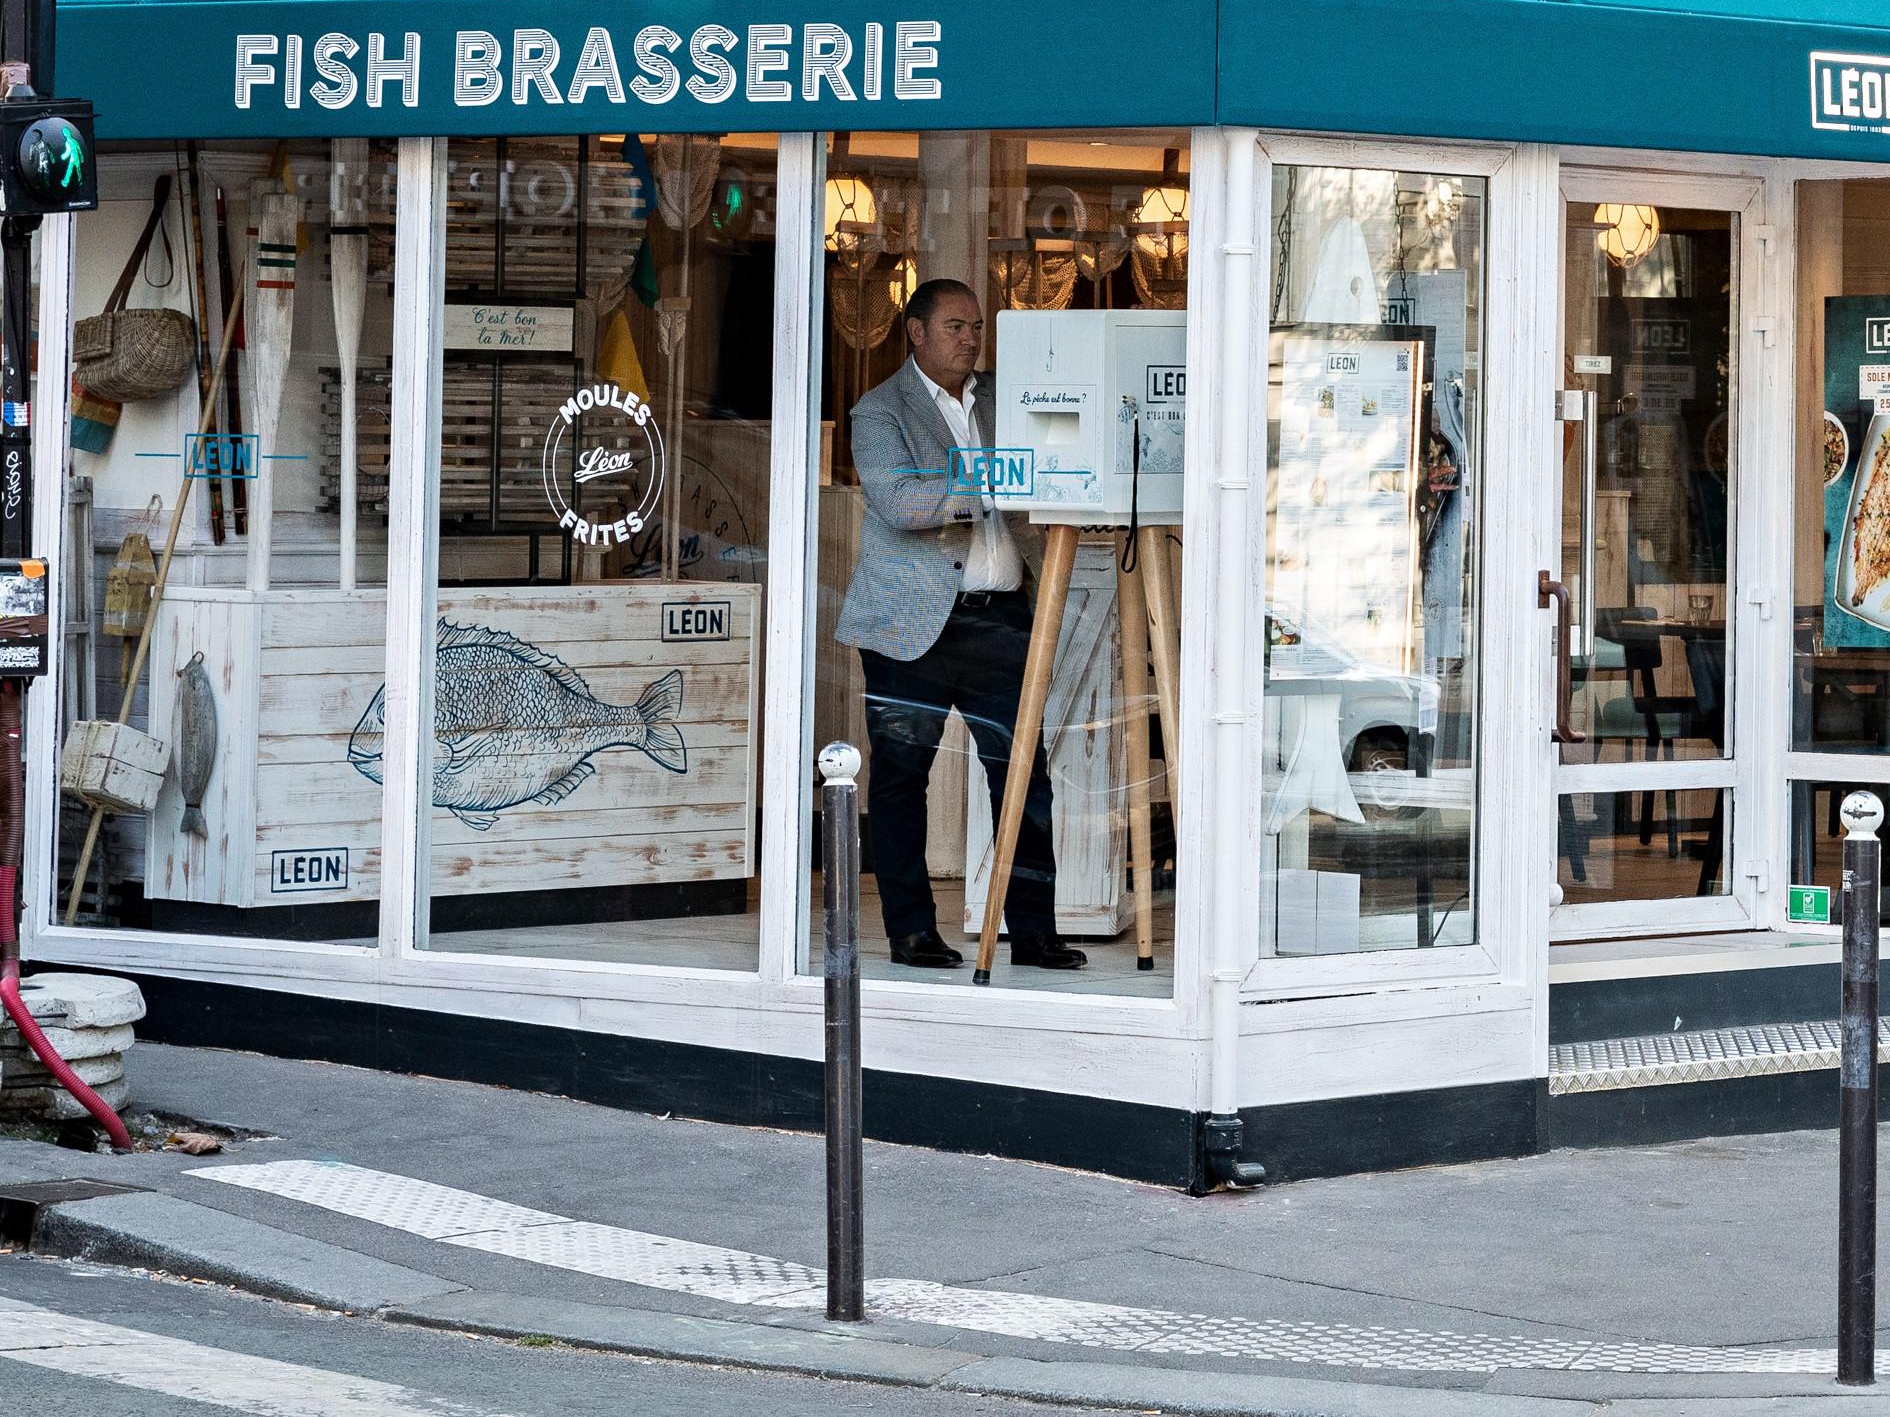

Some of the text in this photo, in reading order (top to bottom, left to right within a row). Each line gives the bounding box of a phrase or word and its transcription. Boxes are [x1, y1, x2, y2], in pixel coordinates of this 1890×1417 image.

[235, 20, 942, 110] FISH BRASSERIE
[515, 309, 537, 325] bon
[479, 327, 492, 345] la
[1153, 371, 1186, 396] LÉO
[1867, 372, 1886, 382] SOLE
[559, 384, 651, 427] MOULES
[1020, 391, 1031, 405] La
[559, 508, 644, 546] FRITES
